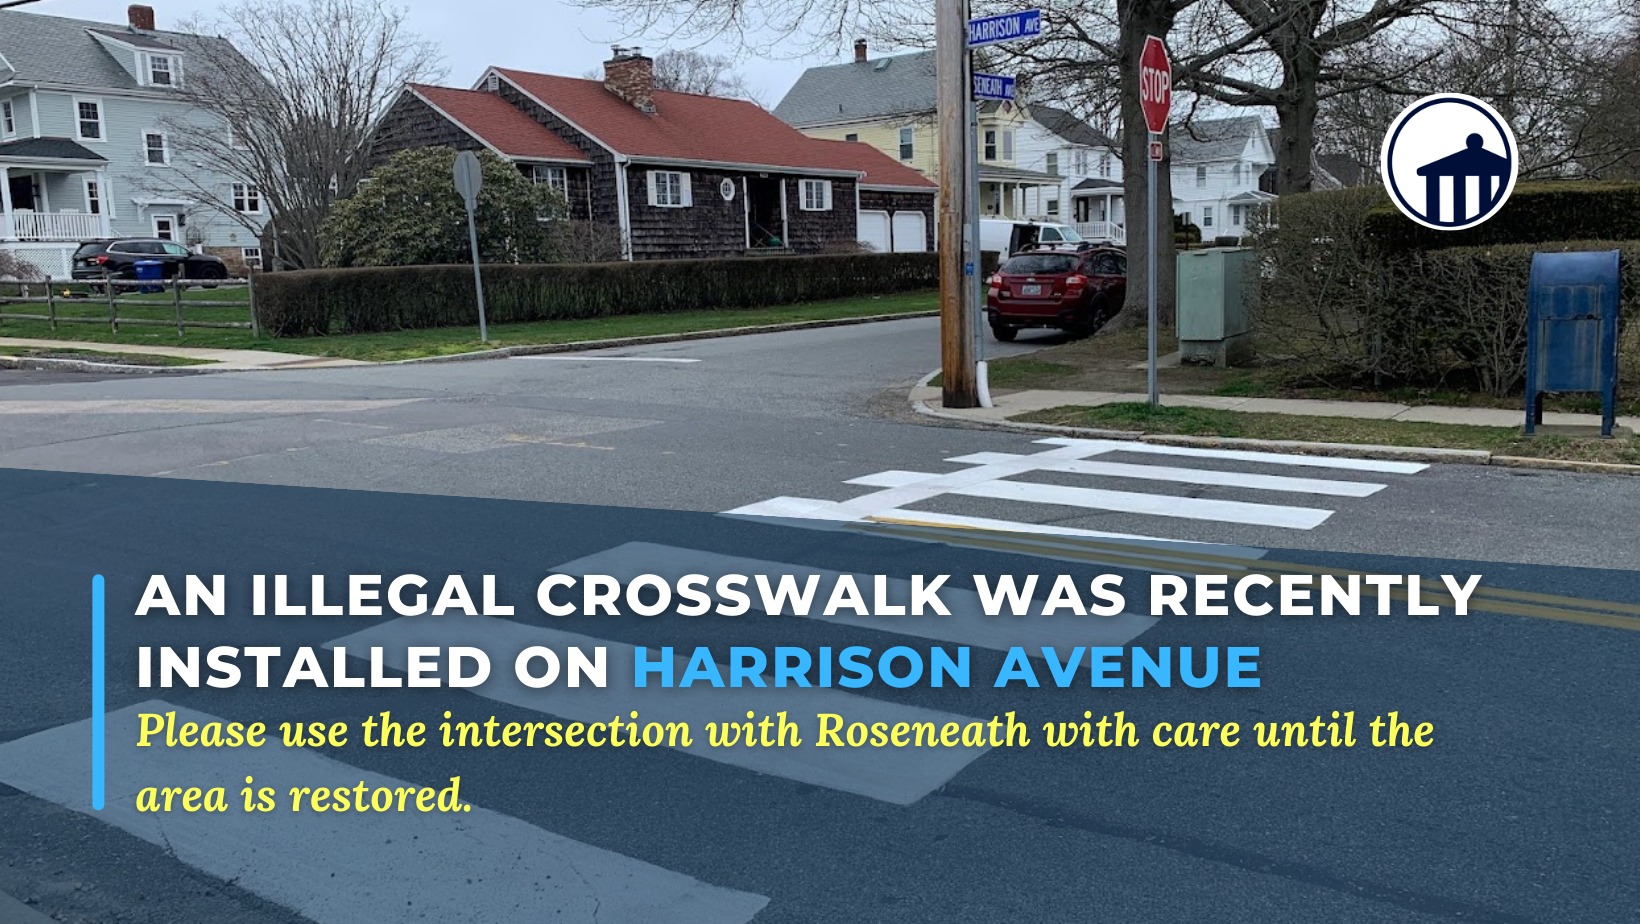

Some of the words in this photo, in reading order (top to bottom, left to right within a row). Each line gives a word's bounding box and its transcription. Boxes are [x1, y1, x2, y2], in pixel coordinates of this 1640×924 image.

[969, 17, 1020, 42] HARRISON
[1024, 17, 1040, 33] AVE
[973, 75, 1003, 95] SENEATH
[1142, 66, 1169, 104] STOP
